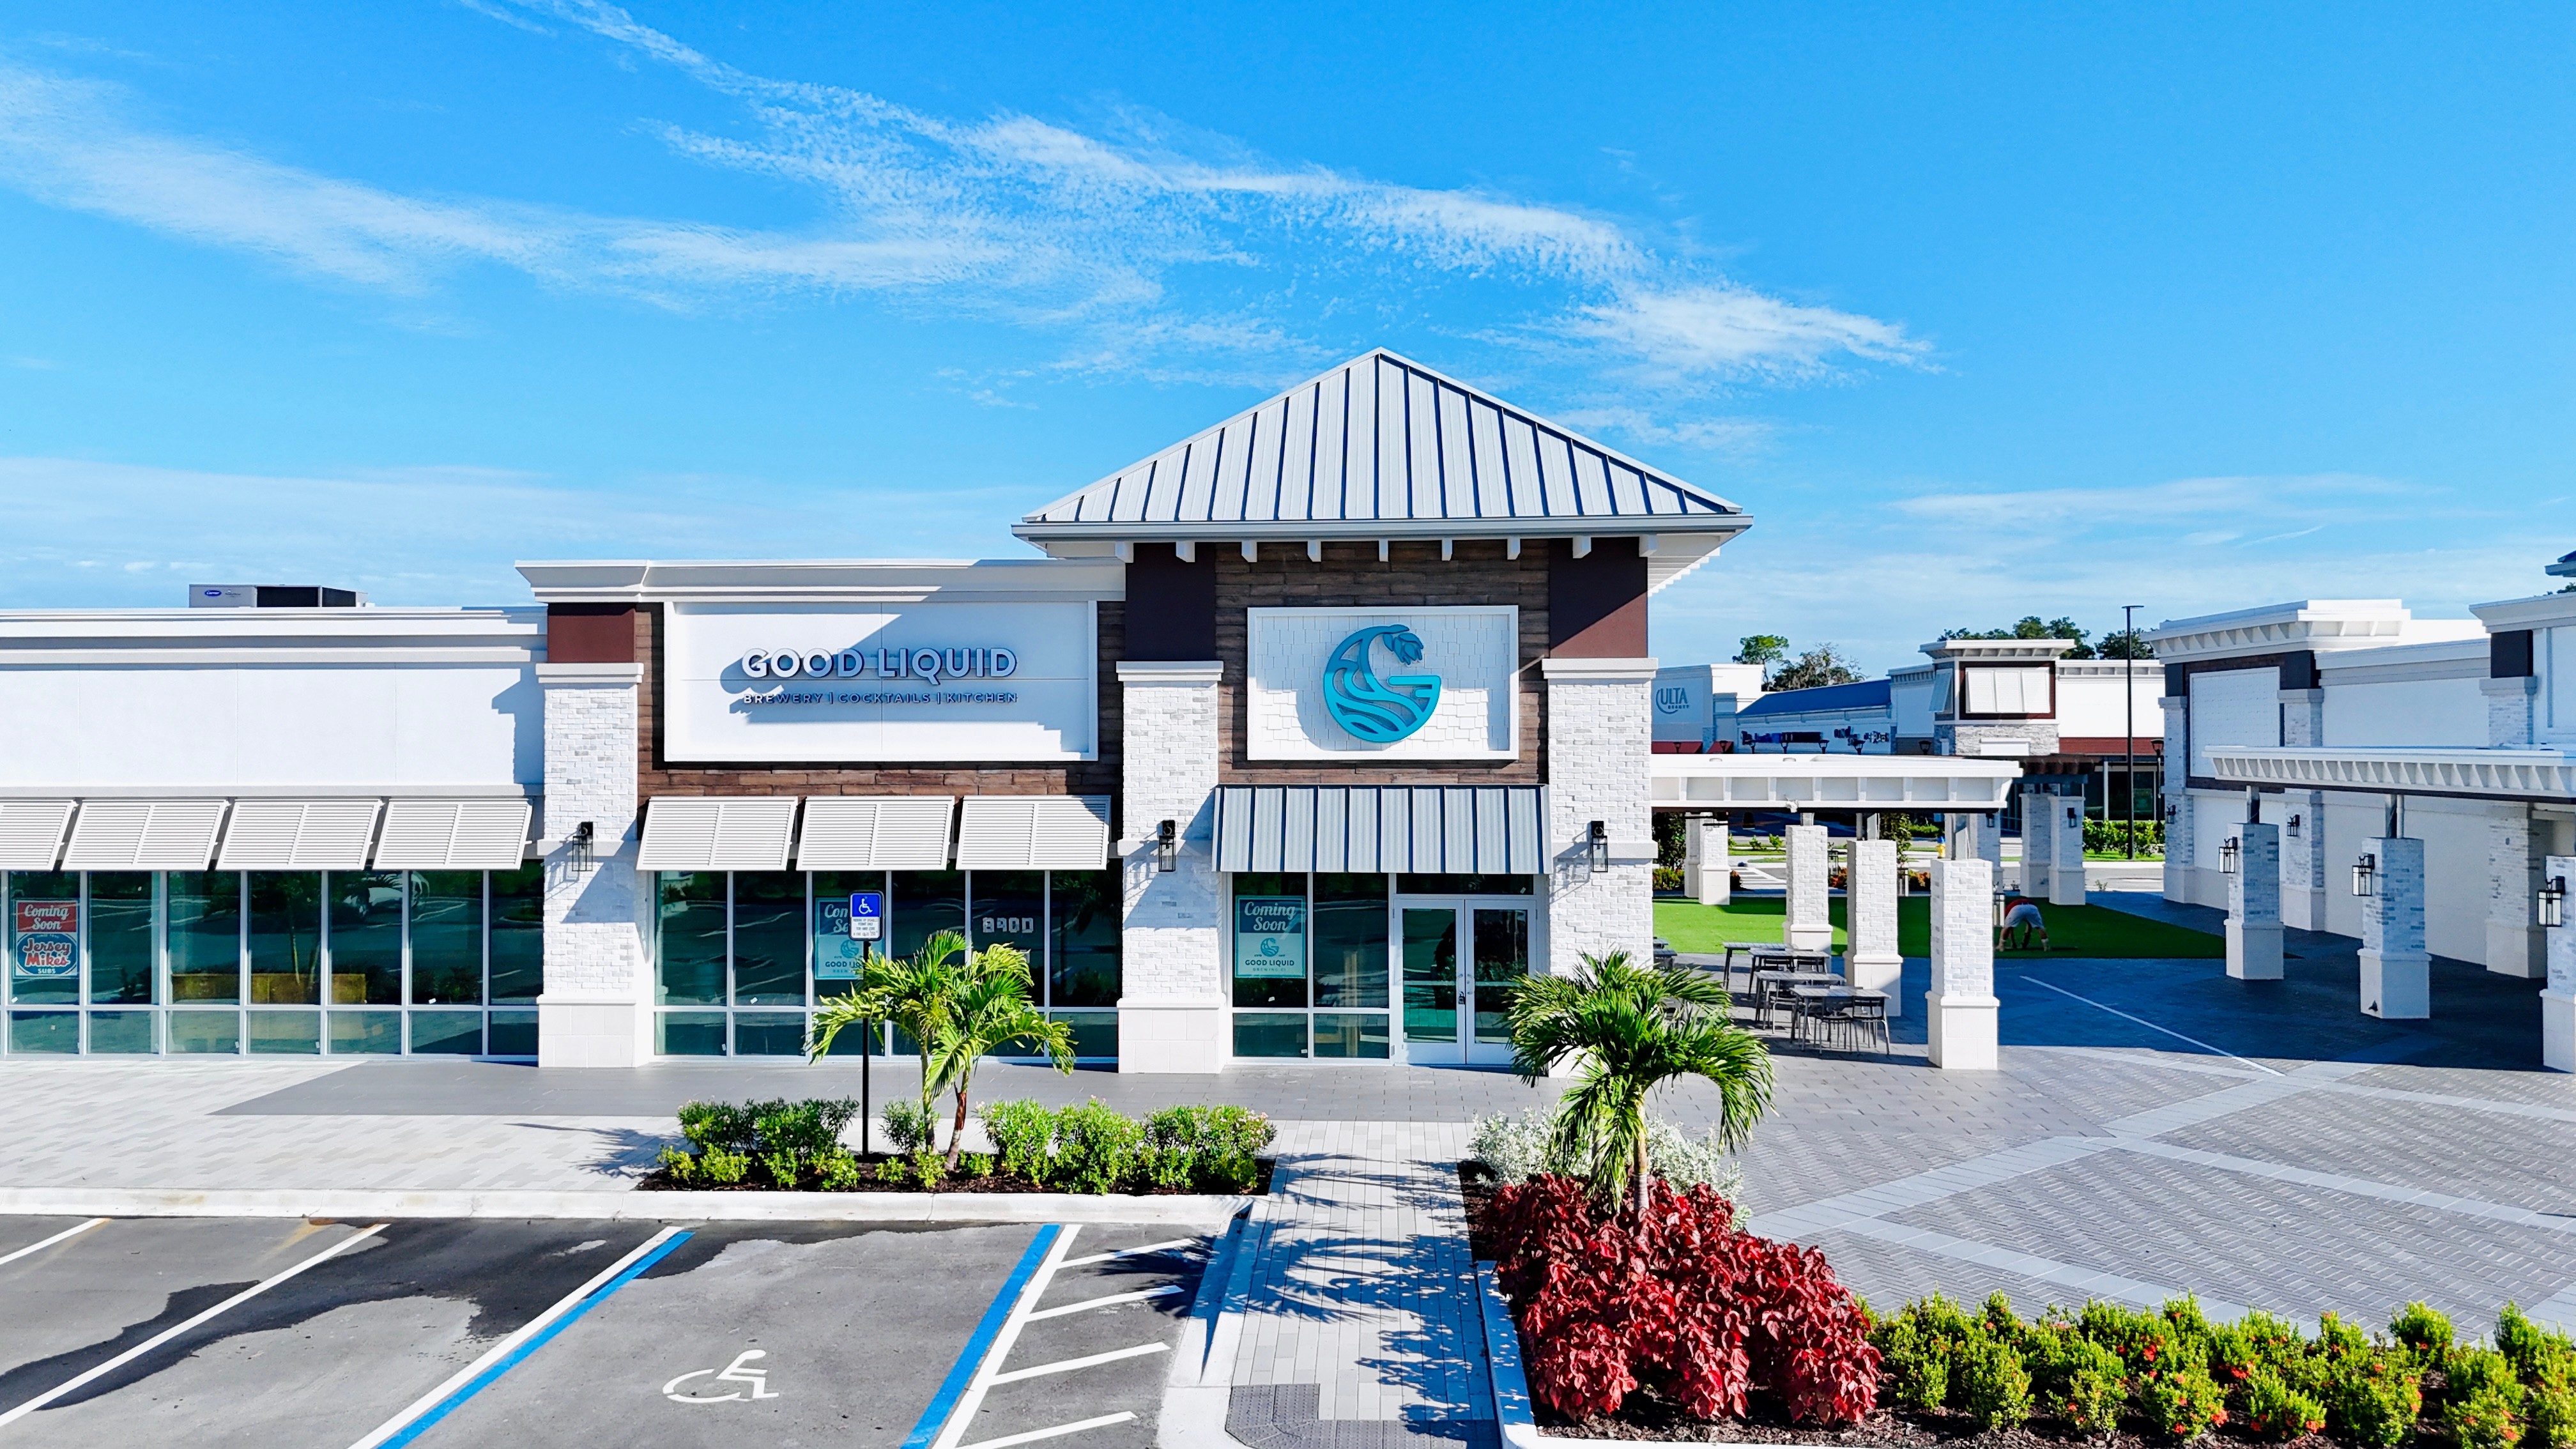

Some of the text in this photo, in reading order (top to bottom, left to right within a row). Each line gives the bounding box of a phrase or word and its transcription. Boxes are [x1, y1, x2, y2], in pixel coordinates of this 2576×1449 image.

[742, 648, 1017, 685] GOOD LIQUID
[743, 693, 824, 703] BREWERY
[839, 693, 931, 703] COCKTAILS
[947, 693, 1018, 703] KITCHEN
[1660, 687, 1688, 705] ULTA
[24, 904, 69, 920] Coming
[824, 904, 848, 918] Com
[1244, 901, 1296, 920] Coming
[32, 917, 62, 930] Soon
[833, 919, 848, 933] So
[1253, 916, 1288, 931] Soon
[22, 938, 72, 956] Jersey
